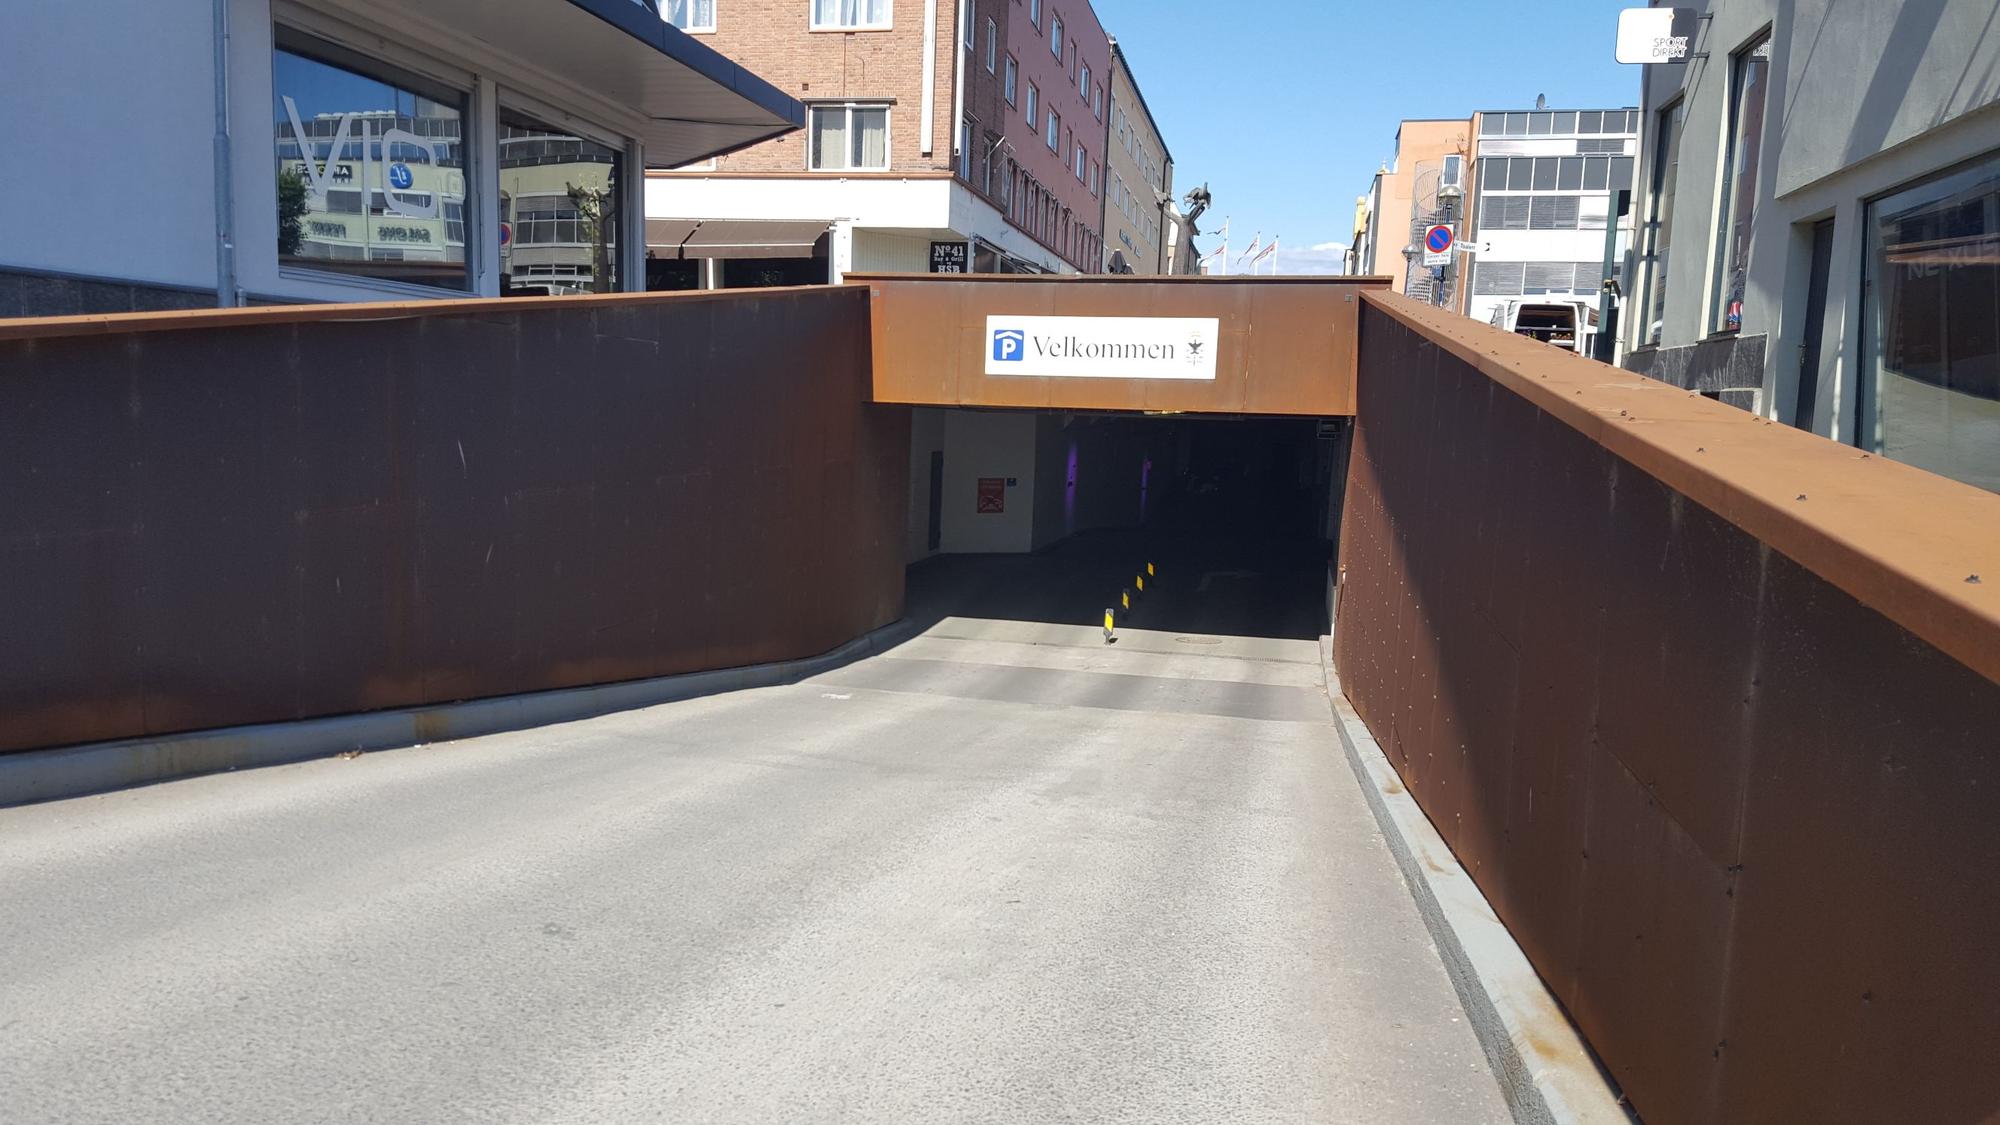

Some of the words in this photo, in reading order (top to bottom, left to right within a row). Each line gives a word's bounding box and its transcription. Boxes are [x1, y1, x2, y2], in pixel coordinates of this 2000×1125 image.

[1654, 37, 1688, 47] SPORT
[1653, 47, 1687, 57] DIREKT
[1002, 338, 1017, 359] P
[1033, 335, 1175, 359] Velkommen
